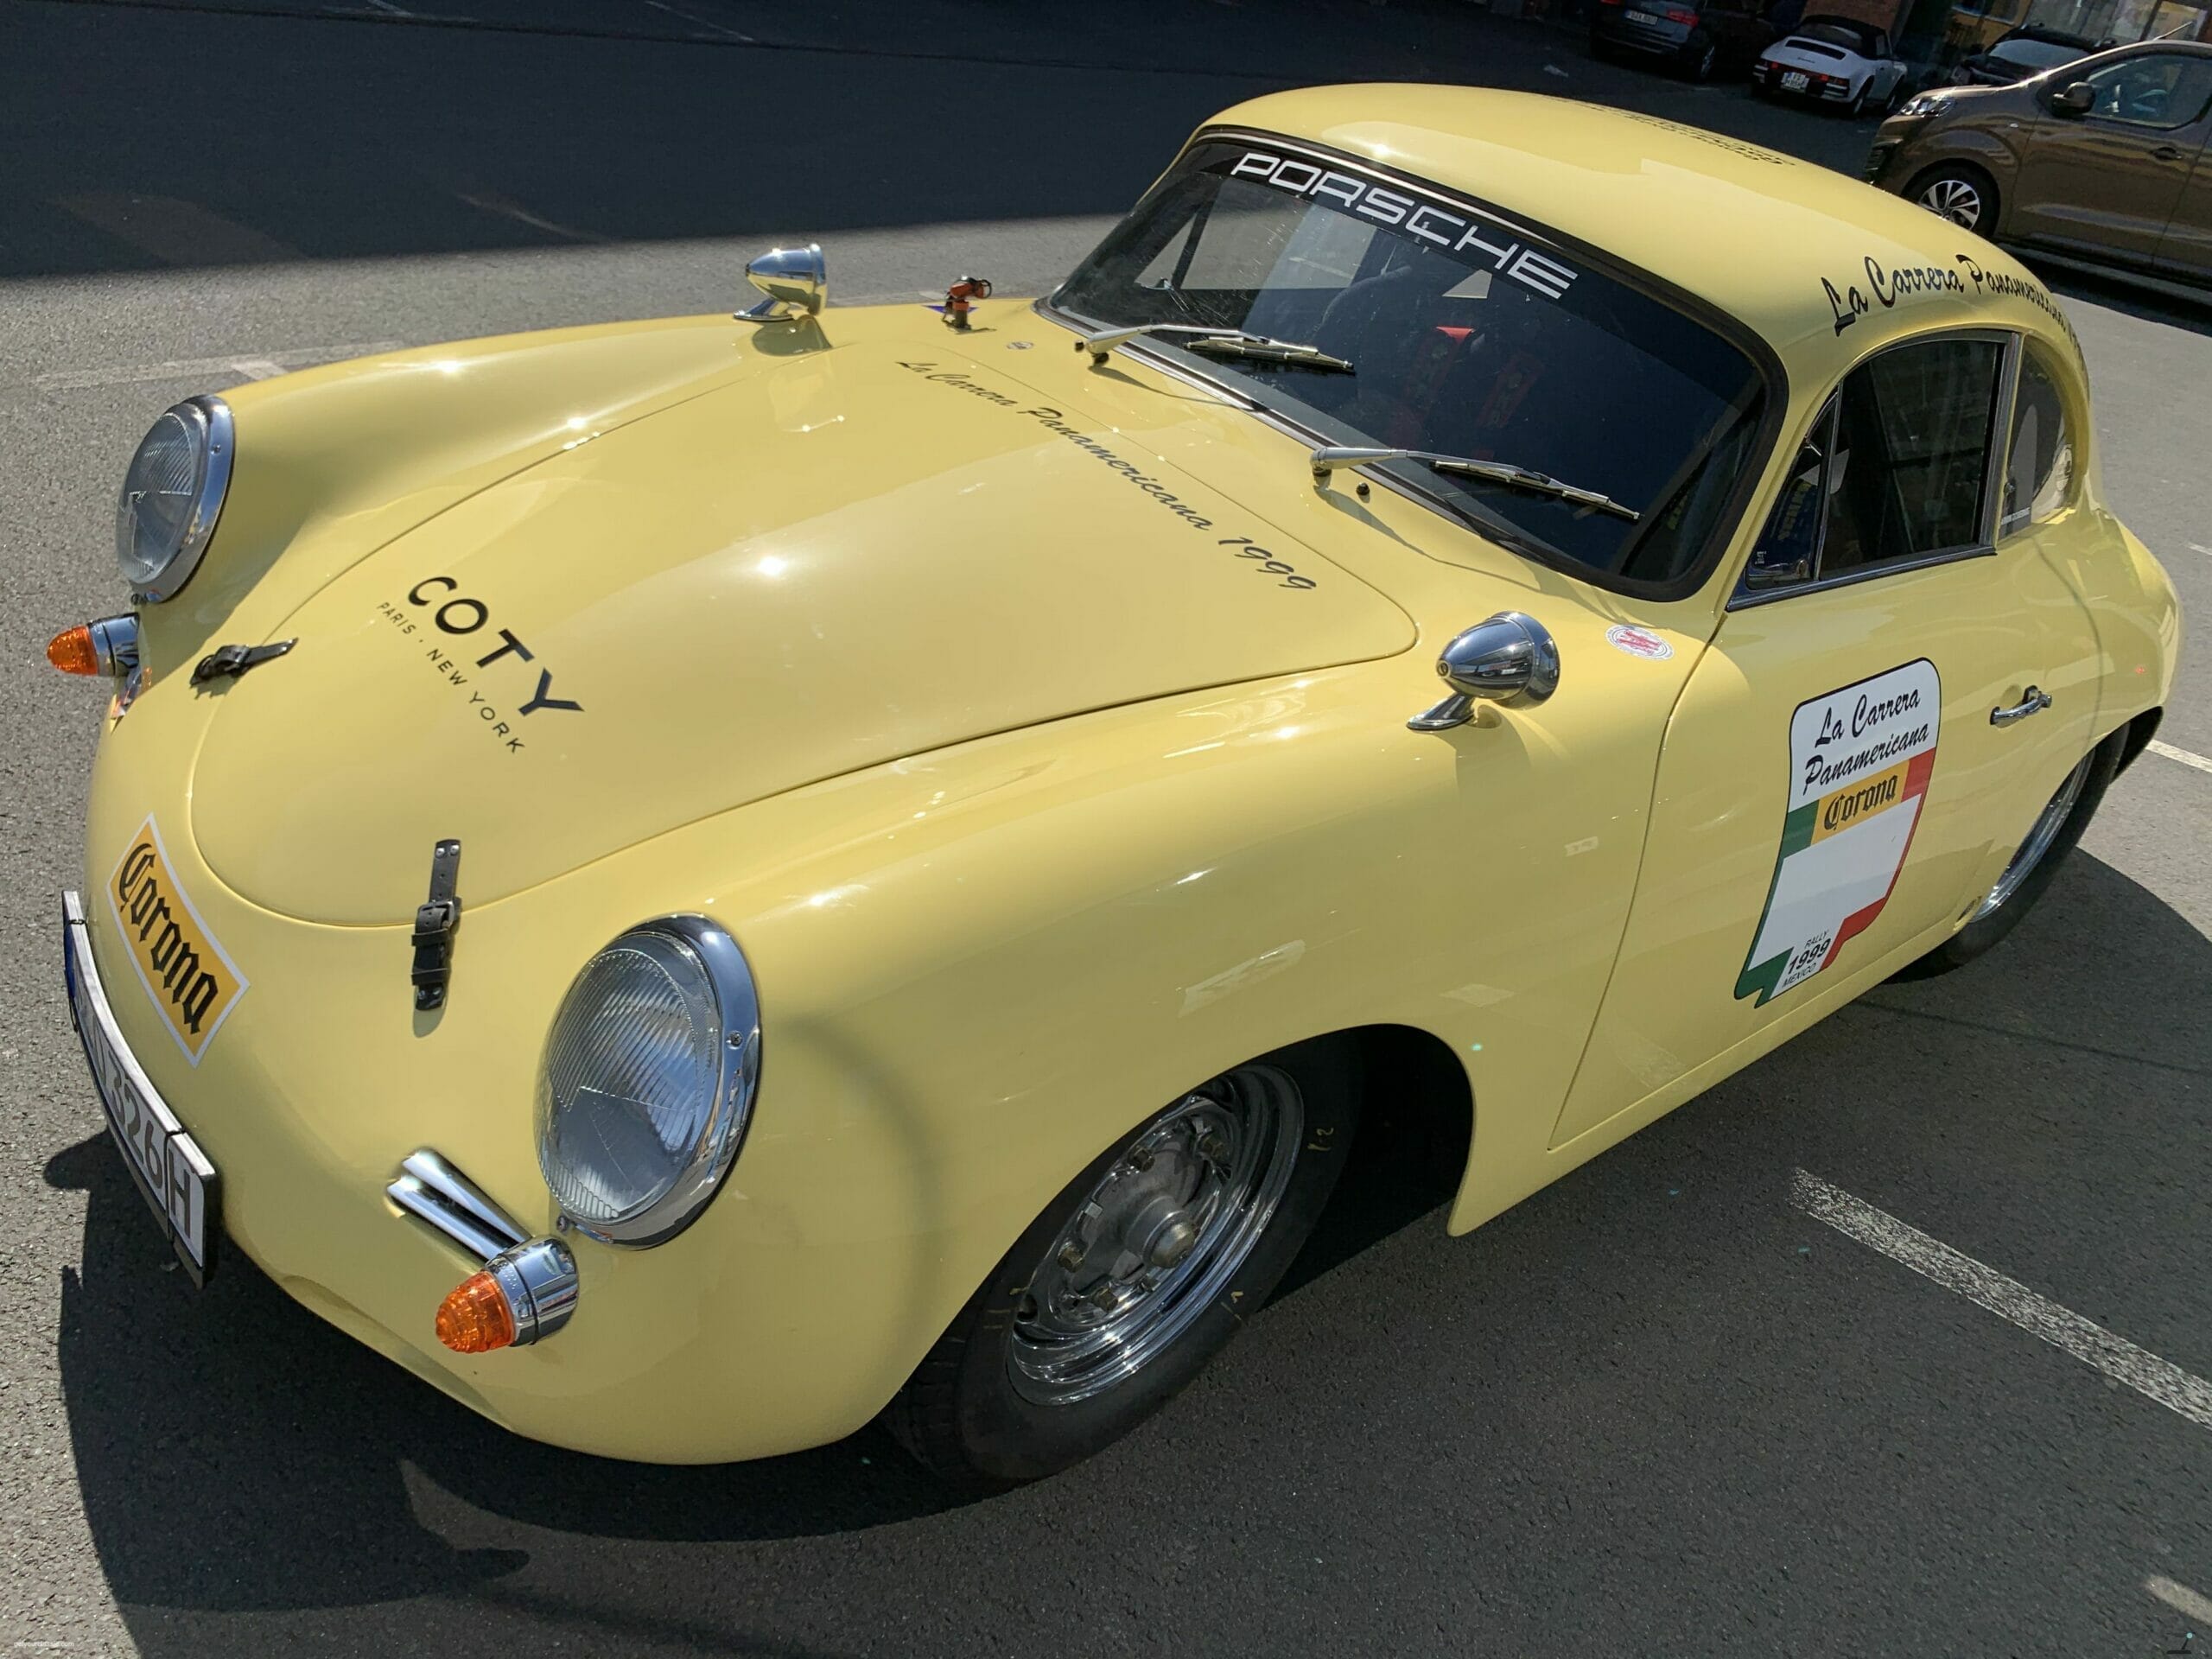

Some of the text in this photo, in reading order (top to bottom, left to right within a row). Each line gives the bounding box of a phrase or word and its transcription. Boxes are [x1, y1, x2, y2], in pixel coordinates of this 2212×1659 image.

[1230, 152, 1579, 300] PORSCHE
[1821, 276, 1869, 338] La
[1864, 256, 1965, 308] Carrera
[894, 361, 1318, 590] La Carrera Panamericana 1999
[376, 602, 525, 753] PARIS NEW YORK
[407, 576, 586, 716] COTY
[1802, 723, 1929, 797] Panamericana
[1815, 689, 1921, 748] La Carrera
[1824, 774, 1898, 831] Corona
[118, 842, 219, 1035] Corona
[1787, 938, 1831, 975] 1999
